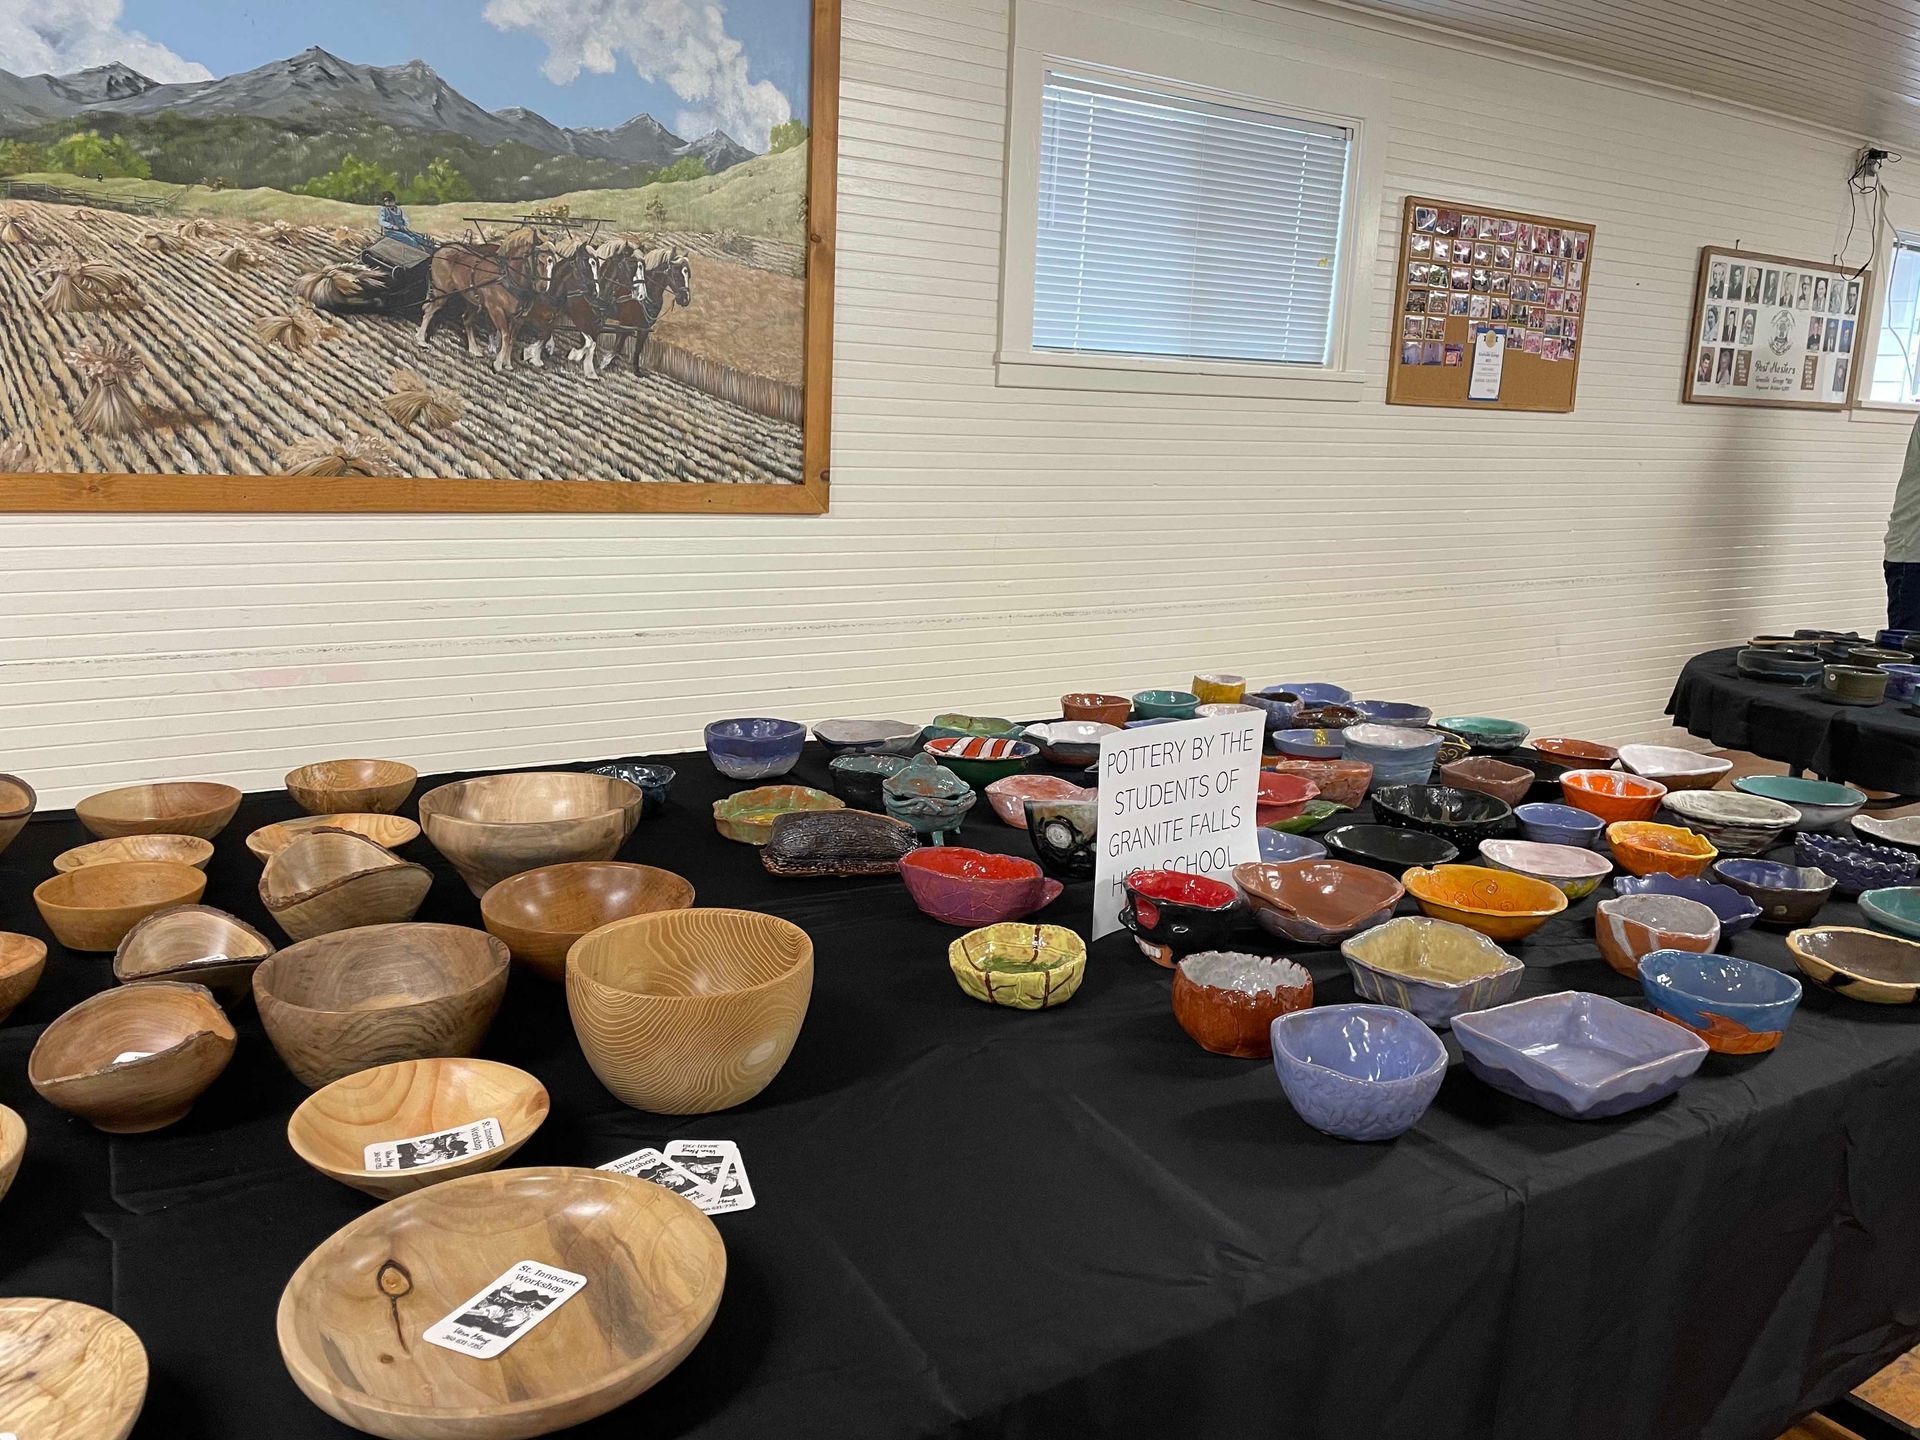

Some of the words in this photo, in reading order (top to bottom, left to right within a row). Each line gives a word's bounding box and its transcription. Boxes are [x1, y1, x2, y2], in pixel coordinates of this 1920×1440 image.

[1107, 739, 1187, 778] POTTERY
[1192, 735, 1215, 761] BY
[1220, 729, 1254, 756] THE
[1114, 774, 1210, 816] STUDENTS
[1215, 768, 1240, 794] OF
[1108, 818, 1184, 858] GRANITE
[1190, 805, 1241, 838] FALLS
[614, 1151, 654, 1170] Innocent
[617, 1157, 657, 1175] orkshop
[515, 1273, 565, 1294] Workshop
[519, 1265, 532, 1274] St.
[534, 1269, 579, 1287] Innocent
